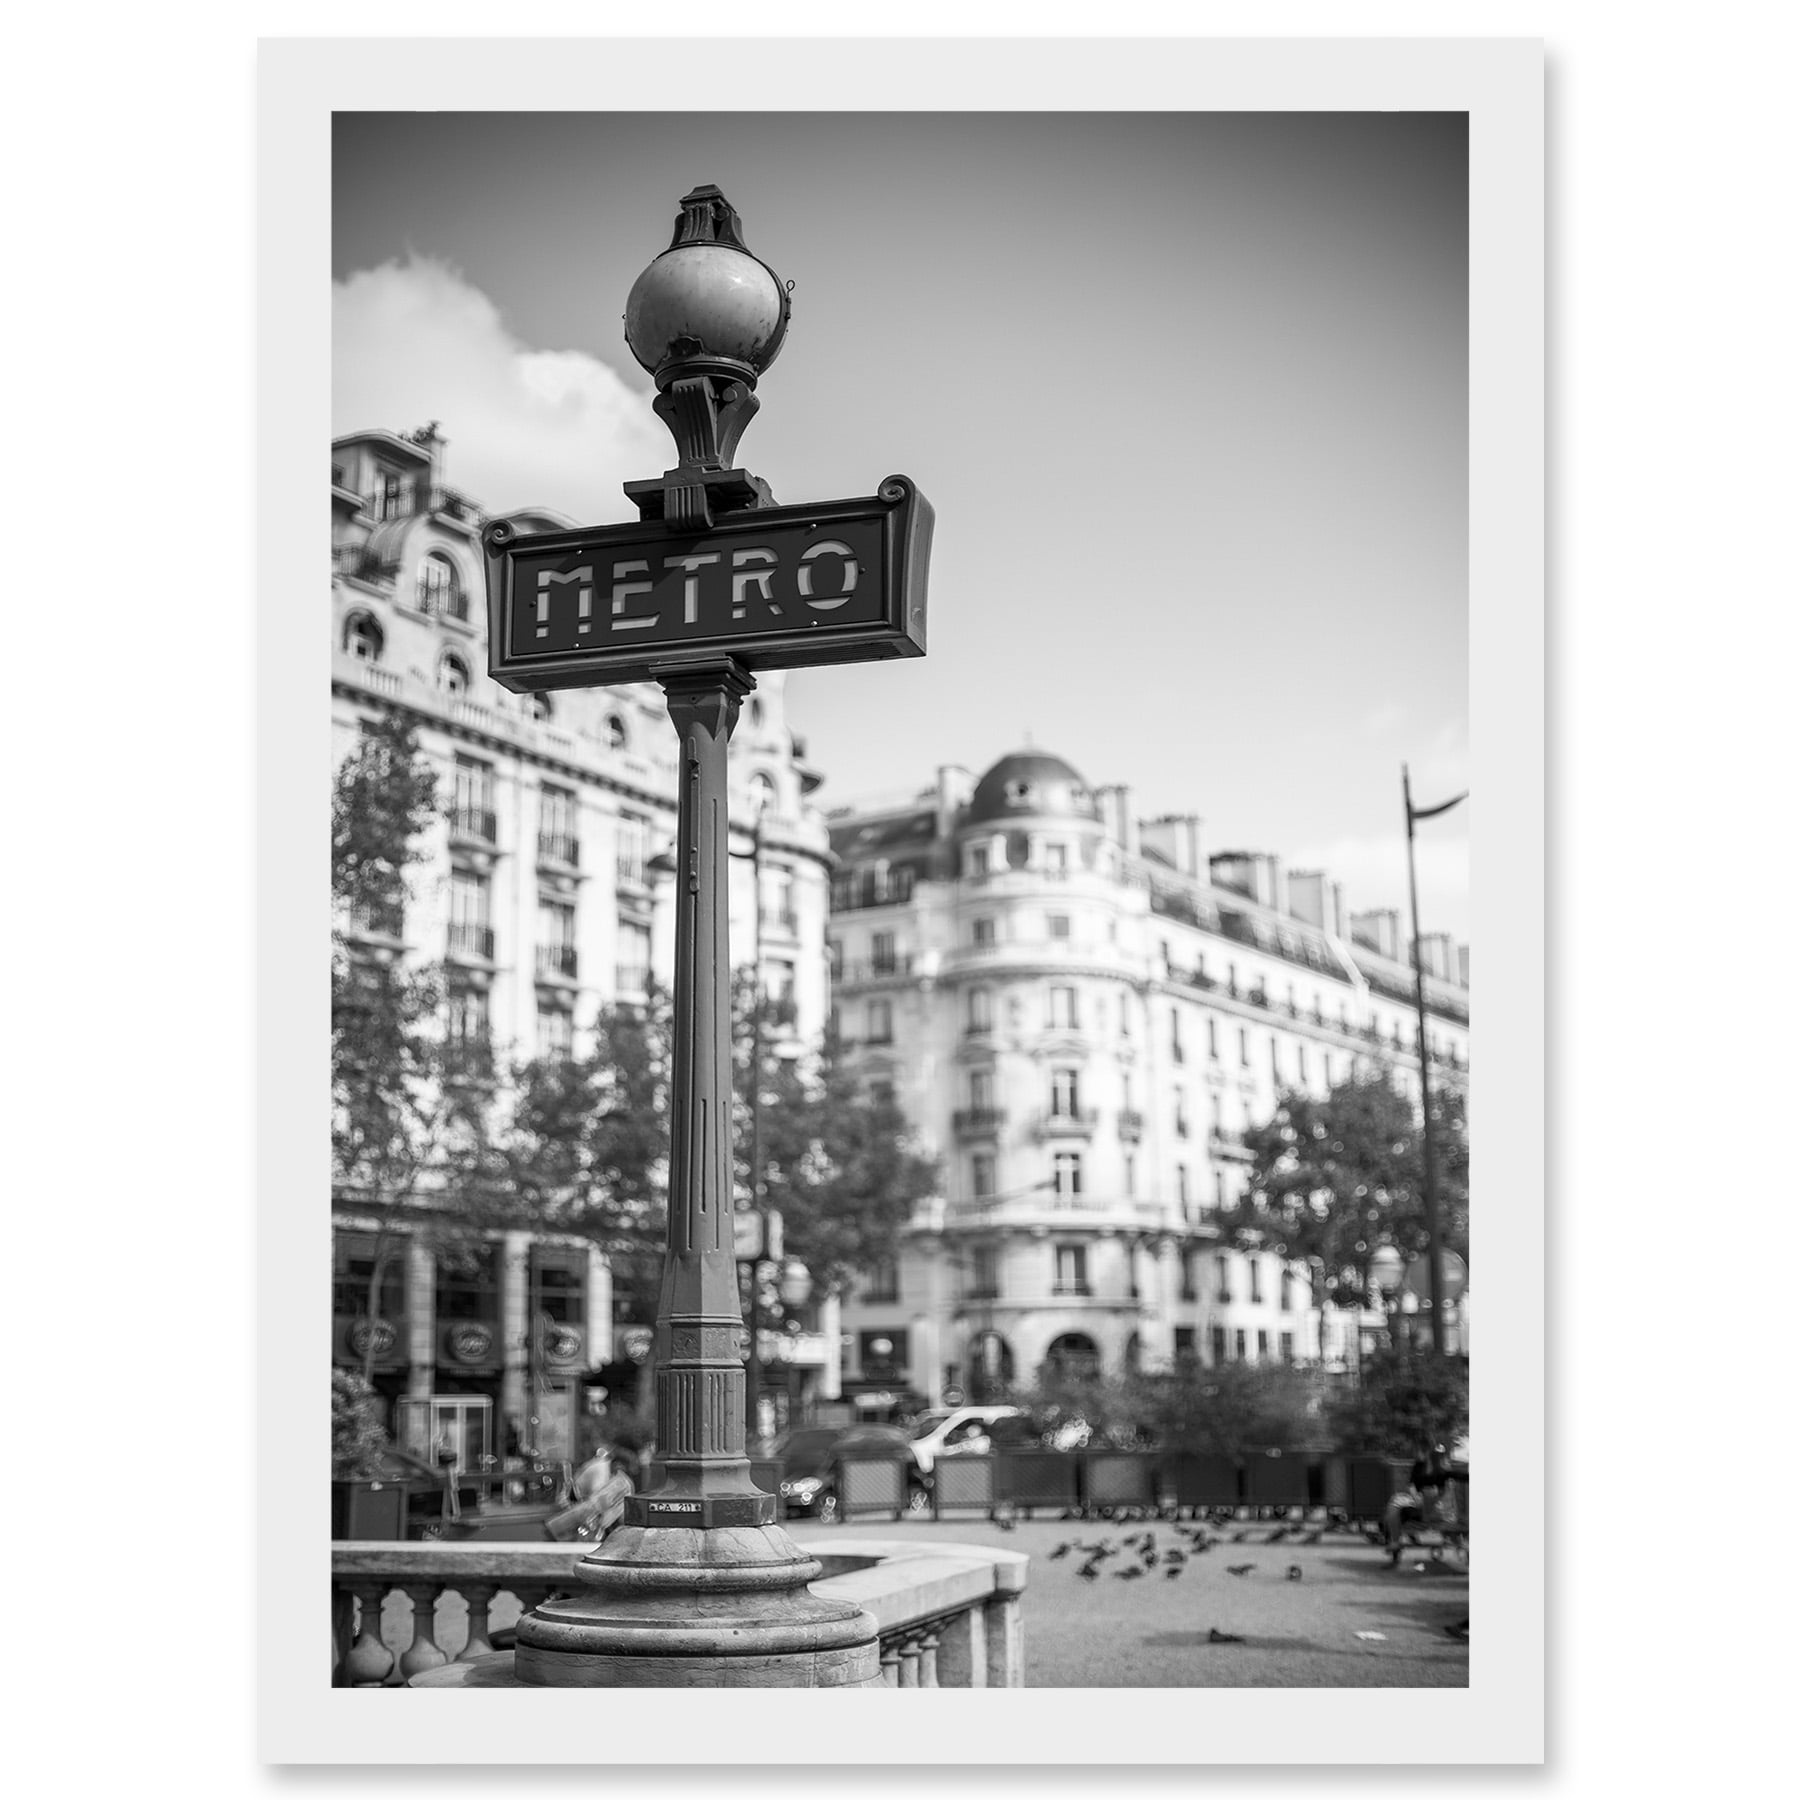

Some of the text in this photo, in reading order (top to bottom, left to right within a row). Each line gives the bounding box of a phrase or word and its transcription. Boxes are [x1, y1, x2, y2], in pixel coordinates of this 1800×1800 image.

[535, 538, 859, 639] METRO
[658, 1503, 692, 1512] CA 211
